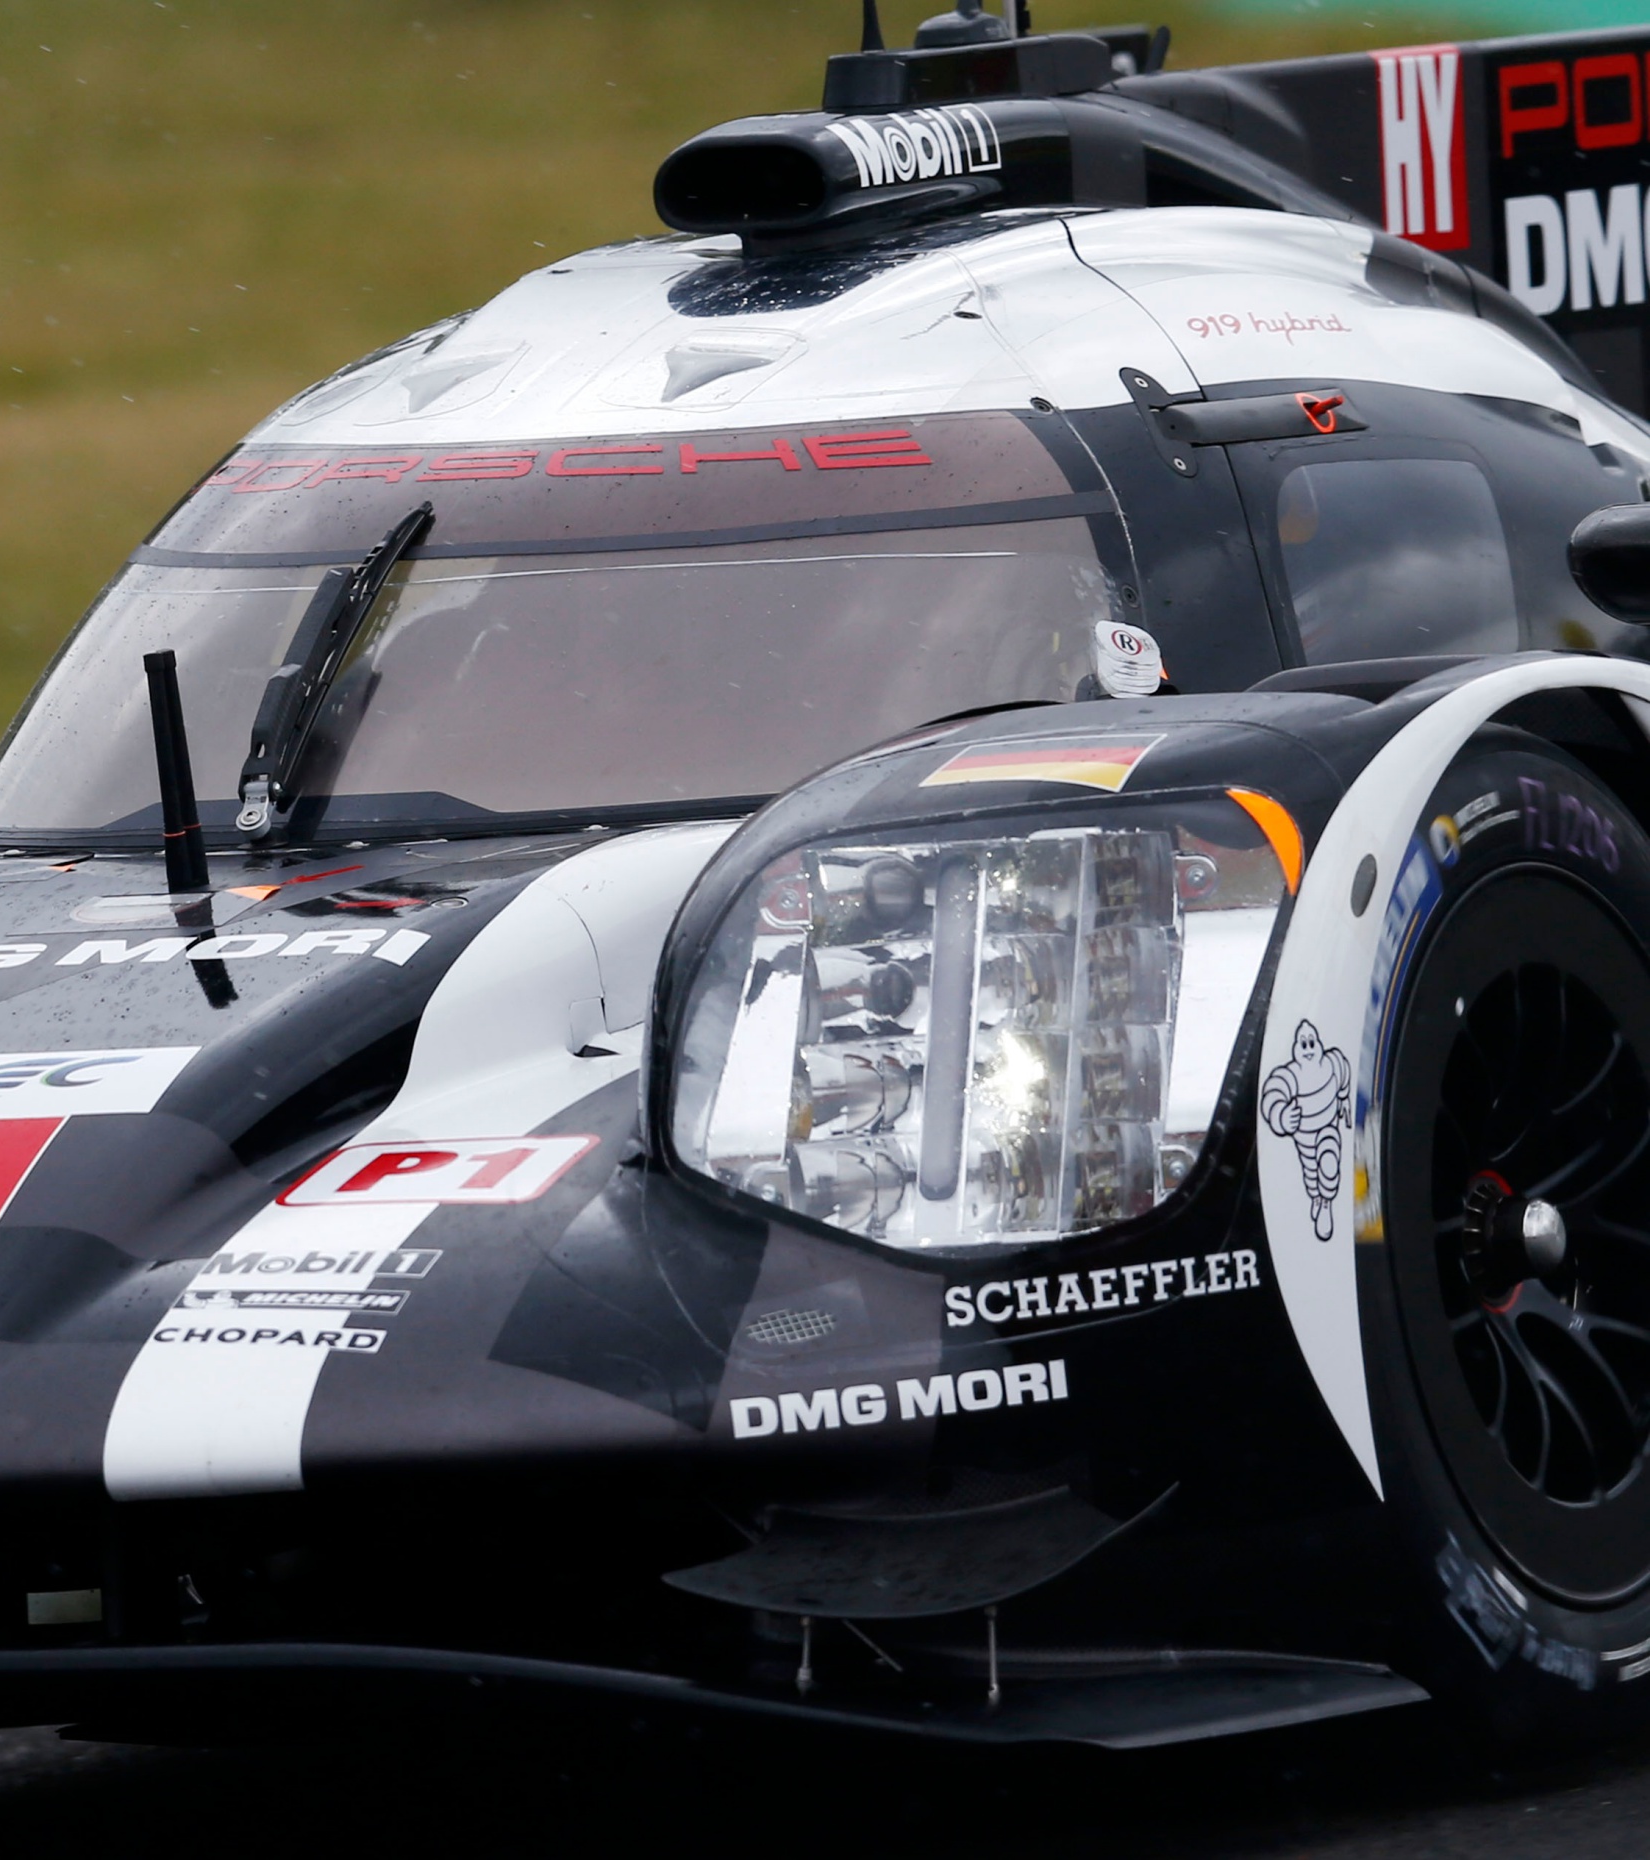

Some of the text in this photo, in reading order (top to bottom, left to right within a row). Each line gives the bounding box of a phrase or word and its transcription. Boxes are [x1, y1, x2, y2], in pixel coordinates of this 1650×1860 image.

[1499, 51, 1650, 159] PO
[825, 108, 963, 188] Mobil
[1378, 53, 1459, 235] HY
[1505, 182, 1650, 317] DM
[1187, 311, 1353, 346] 919 hybrid
[54, 928, 432, 967] MORI
[336, 1147, 540, 1192] P1
[200, 1249, 377, 1276] Mobil
[944, 1249, 1261, 1327] SCHAEFFLER
[239, 1290, 407, 1309] MICHELIN
[153, 1328, 378, 1351] CHOPARD
[729, 1358, 1069, 1439] DMG MORI
